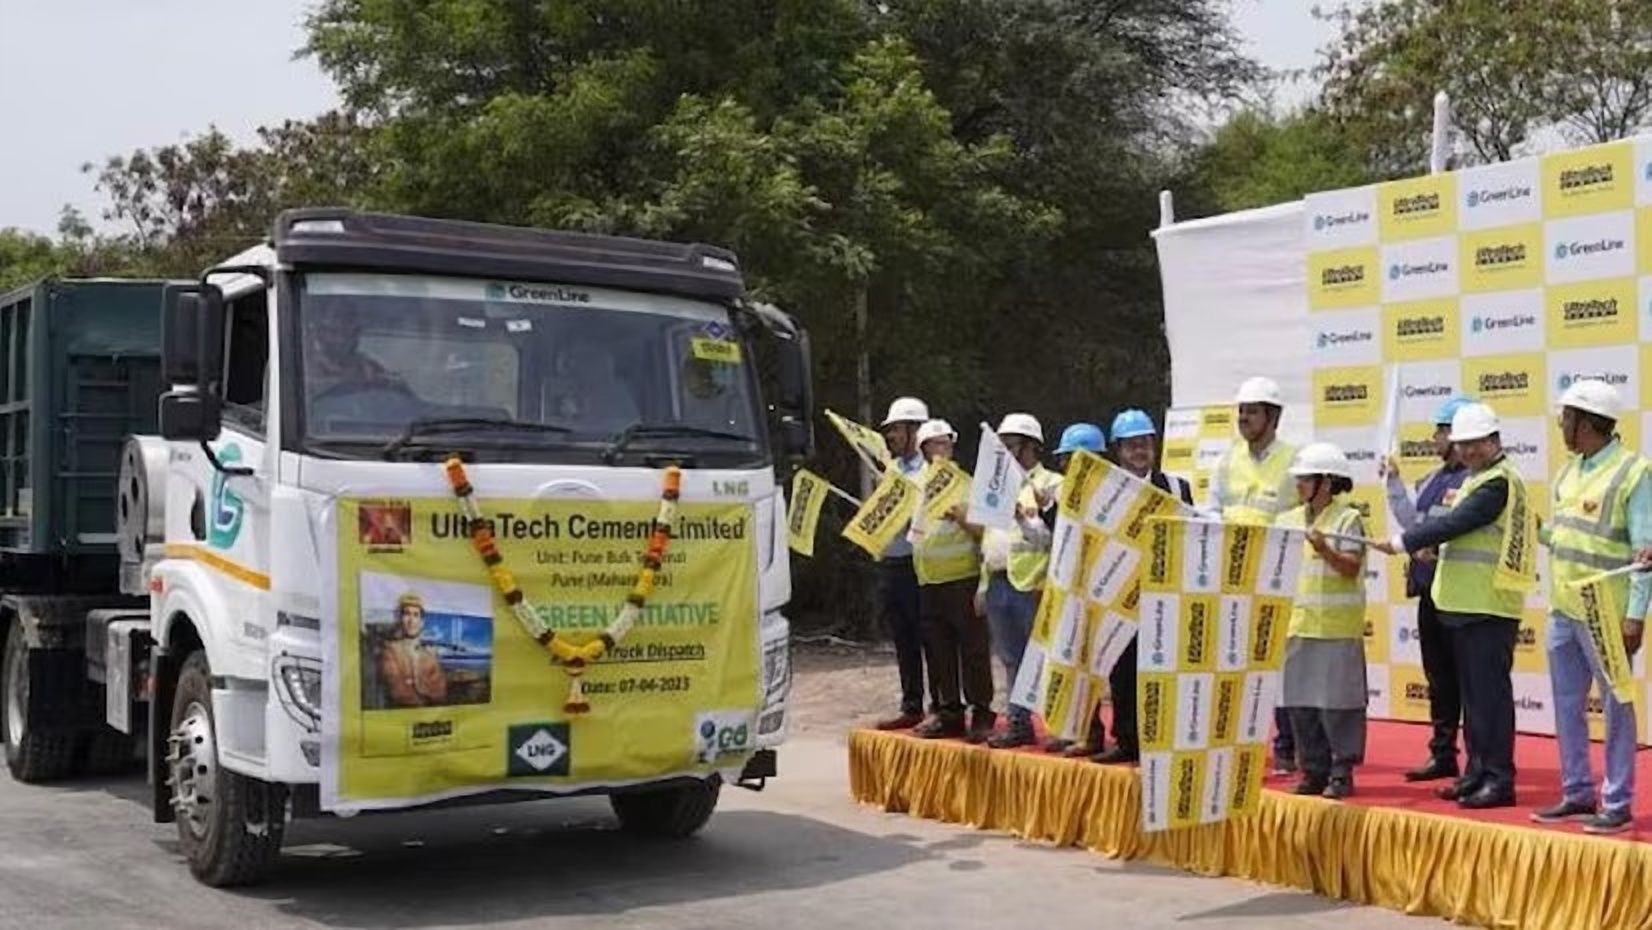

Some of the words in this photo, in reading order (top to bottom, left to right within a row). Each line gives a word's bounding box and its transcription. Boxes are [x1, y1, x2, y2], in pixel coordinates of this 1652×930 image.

[1480, 186, 1531, 203] GreenLine
[1326, 212, 1369, 226] GreenLine
[1570, 239, 1624, 256] GreenLine
[1402, 262, 1448, 276] GreenLine
[509, 284, 591, 303] GreenLine
[1484, 316, 1535, 330] GreenLine
[1405, 386, 1452, 398] GreenLine
[537, 550, 568, 564] Unit:
[572, 551, 604, 564] Pune
[537, 603, 607, 627] GREEN
[649, 641, 705, 660] Dispatch
[528, 743, 556, 758] LNG
